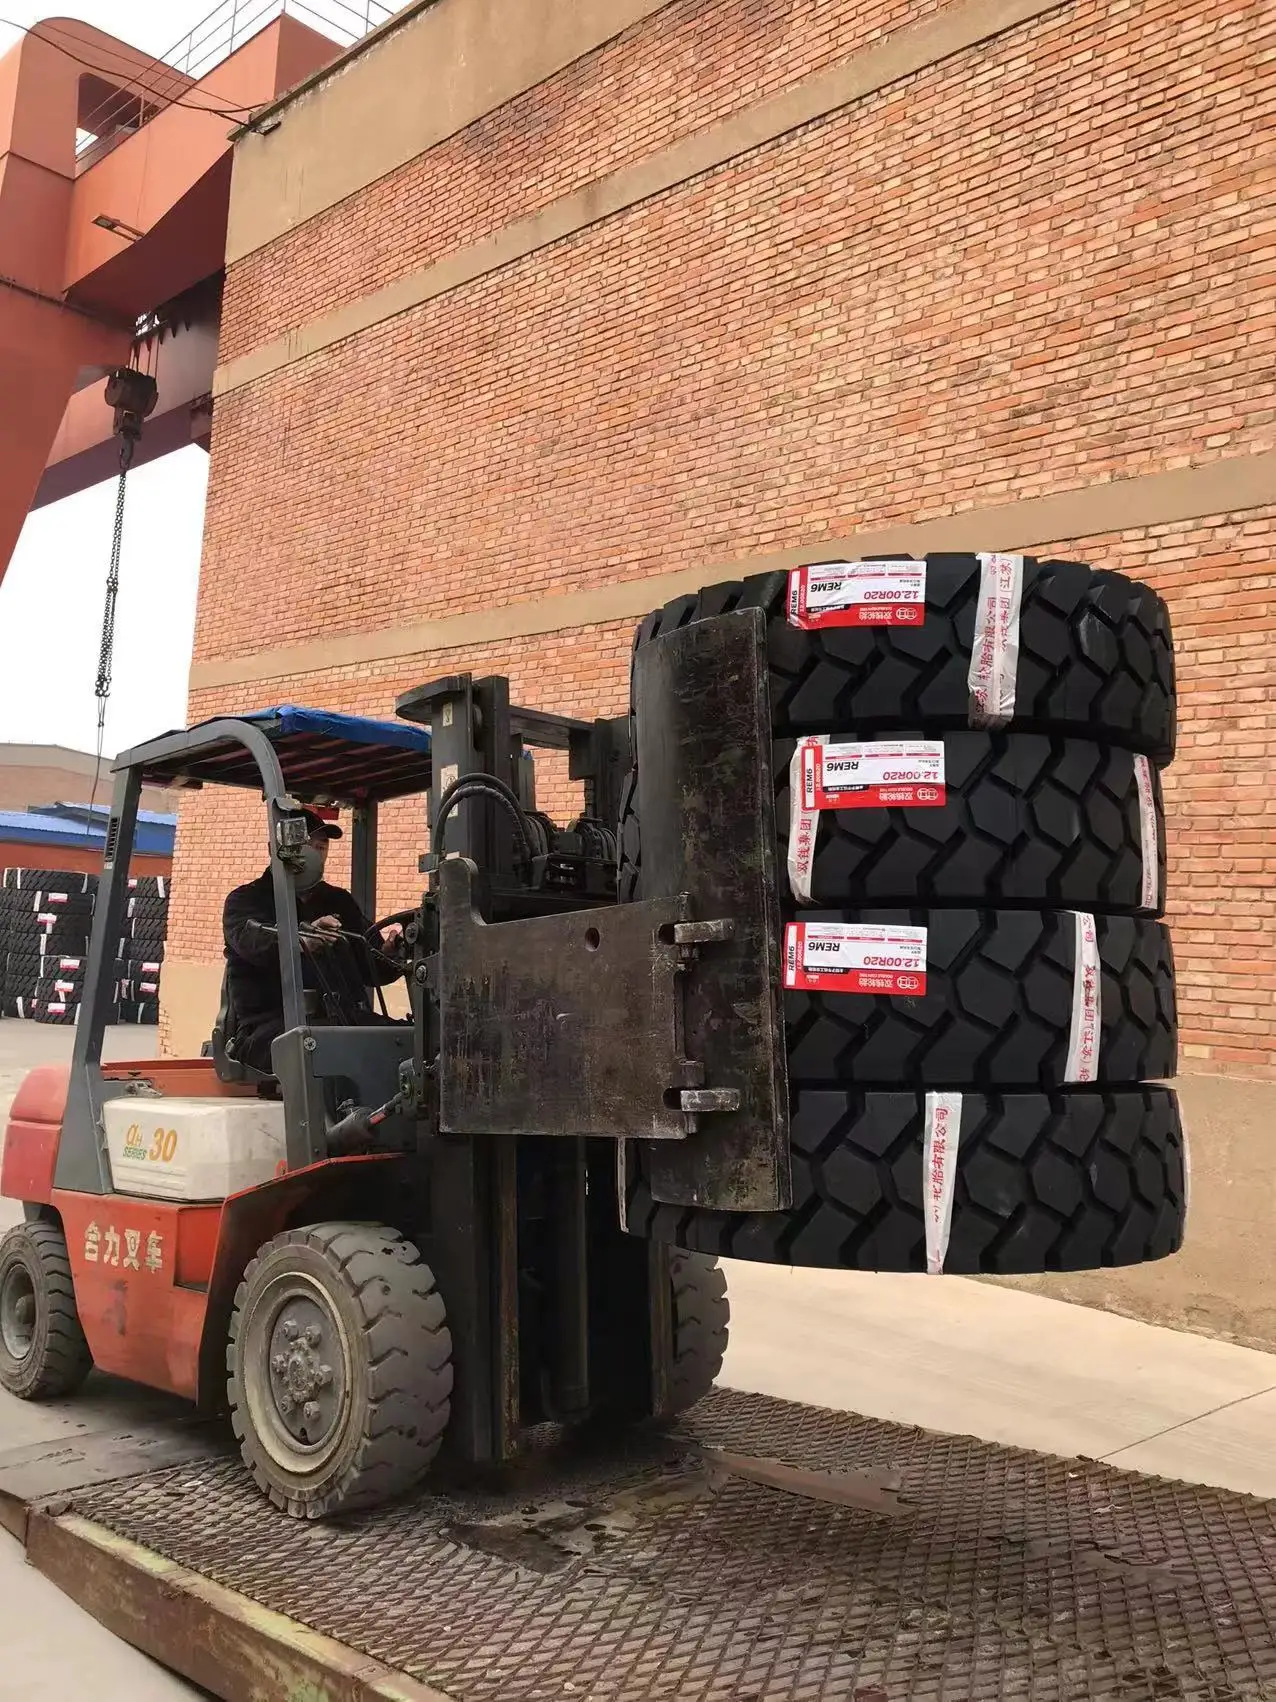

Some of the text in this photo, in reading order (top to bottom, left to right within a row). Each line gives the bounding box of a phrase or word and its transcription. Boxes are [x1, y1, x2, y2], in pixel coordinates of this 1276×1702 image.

[810, 582, 842, 593] REM6
[863, 590, 919, 600] 12.00R20
[790, 590, 799, 615] REM6
[826, 761, 860, 772] REM6
[806, 768, 814, 794] REM6
[882, 771, 939, 780] 12.00R20
[808, 941, 841, 952] REM6
[787, 945, 796, 971] REM6
[863, 956, 920, 968] 12.00R20
[148, 1126, 178, 1162] 30
[122, 1145, 148, 1161] SERIES
[84, 1220, 164, 1274] 合力叉车
